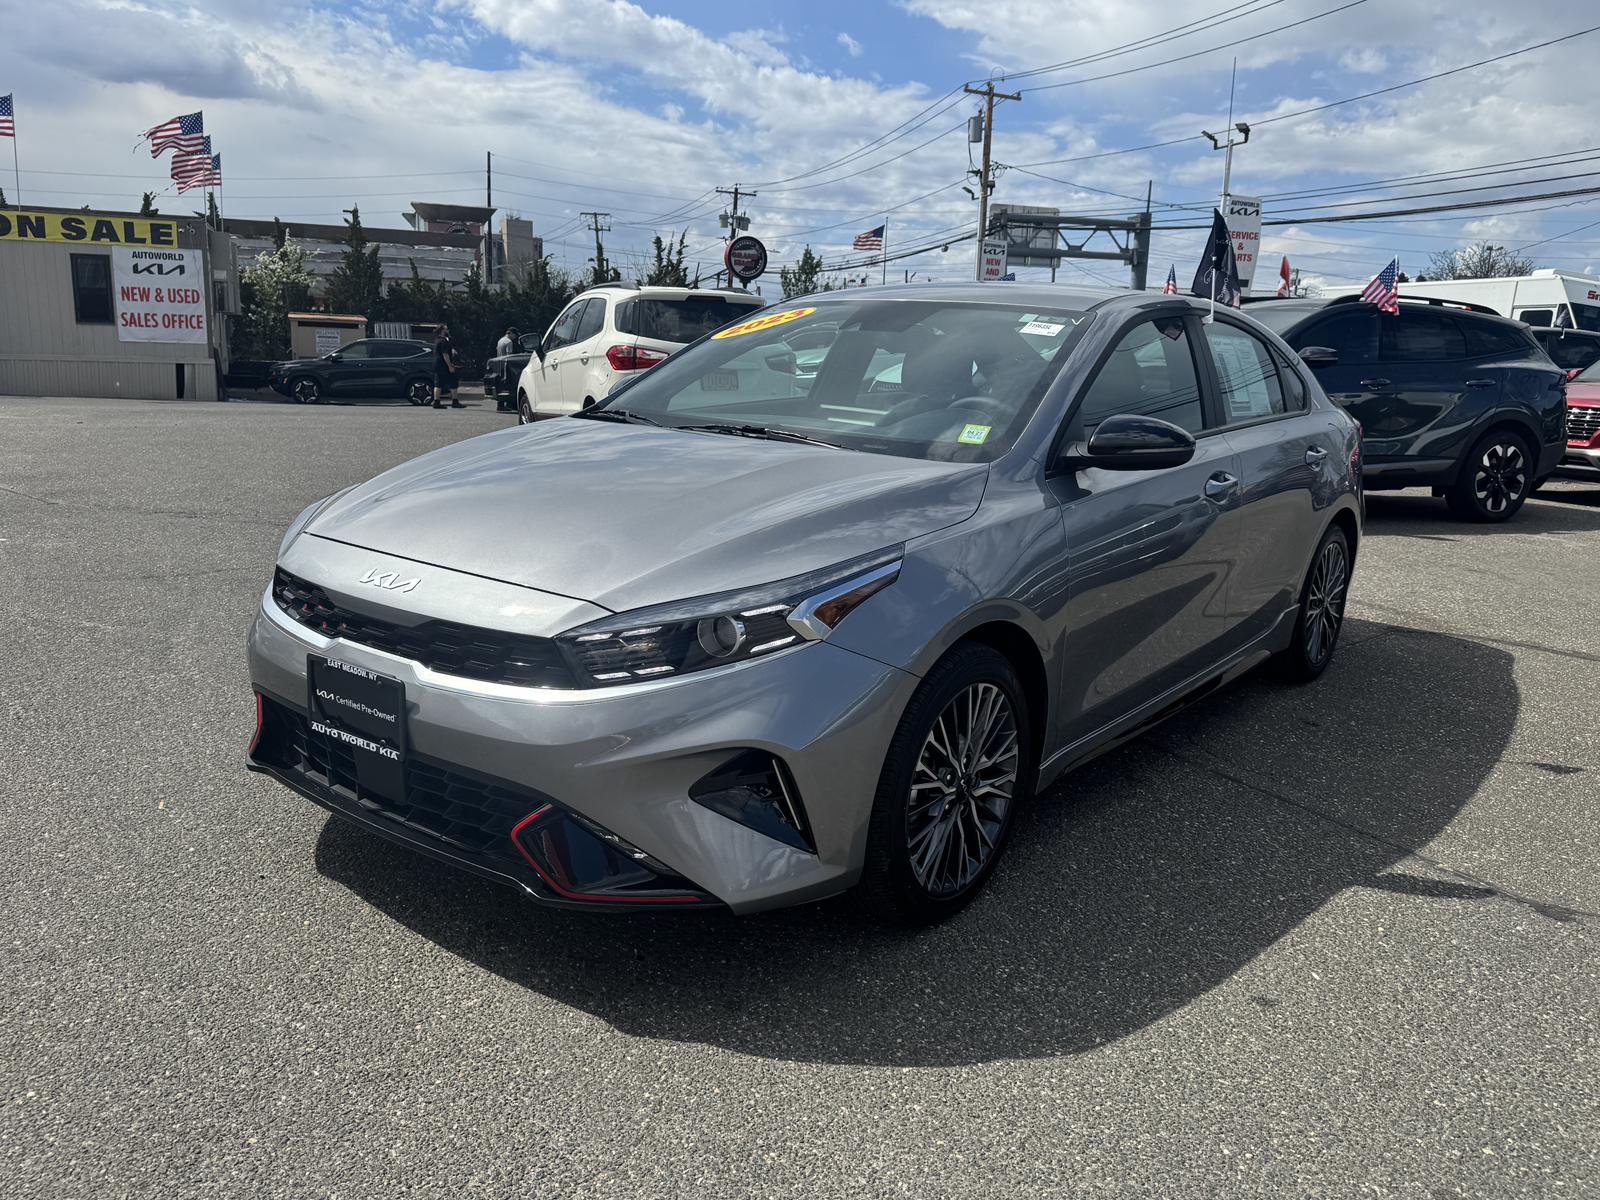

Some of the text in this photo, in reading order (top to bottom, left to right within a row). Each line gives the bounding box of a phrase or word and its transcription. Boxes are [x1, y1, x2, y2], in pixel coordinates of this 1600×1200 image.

[1230, 207, 1260, 216] KIA
[1231, 200, 1259, 208] AUTOWORLD
[61, 217, 173, 245] SALE
[1237, 242, 1244, 250] &
[132, 251, 184, 261] AUTOWORLD
[986, 258, 1001, 266] NEW
[132, 262, 186, 276] KIA
[120, 285, 200, 304] NEW & USED
[120, 312, 204, 329] SALES OFFICE
[721, 309, 806, 338] 2023
[327, 659, 341, 670] EAST
[368, 671, 378, 681] NY
[336, 696, 360, 711] Certified
[311, 721, 400, 760] AUTO WORLD KIA
